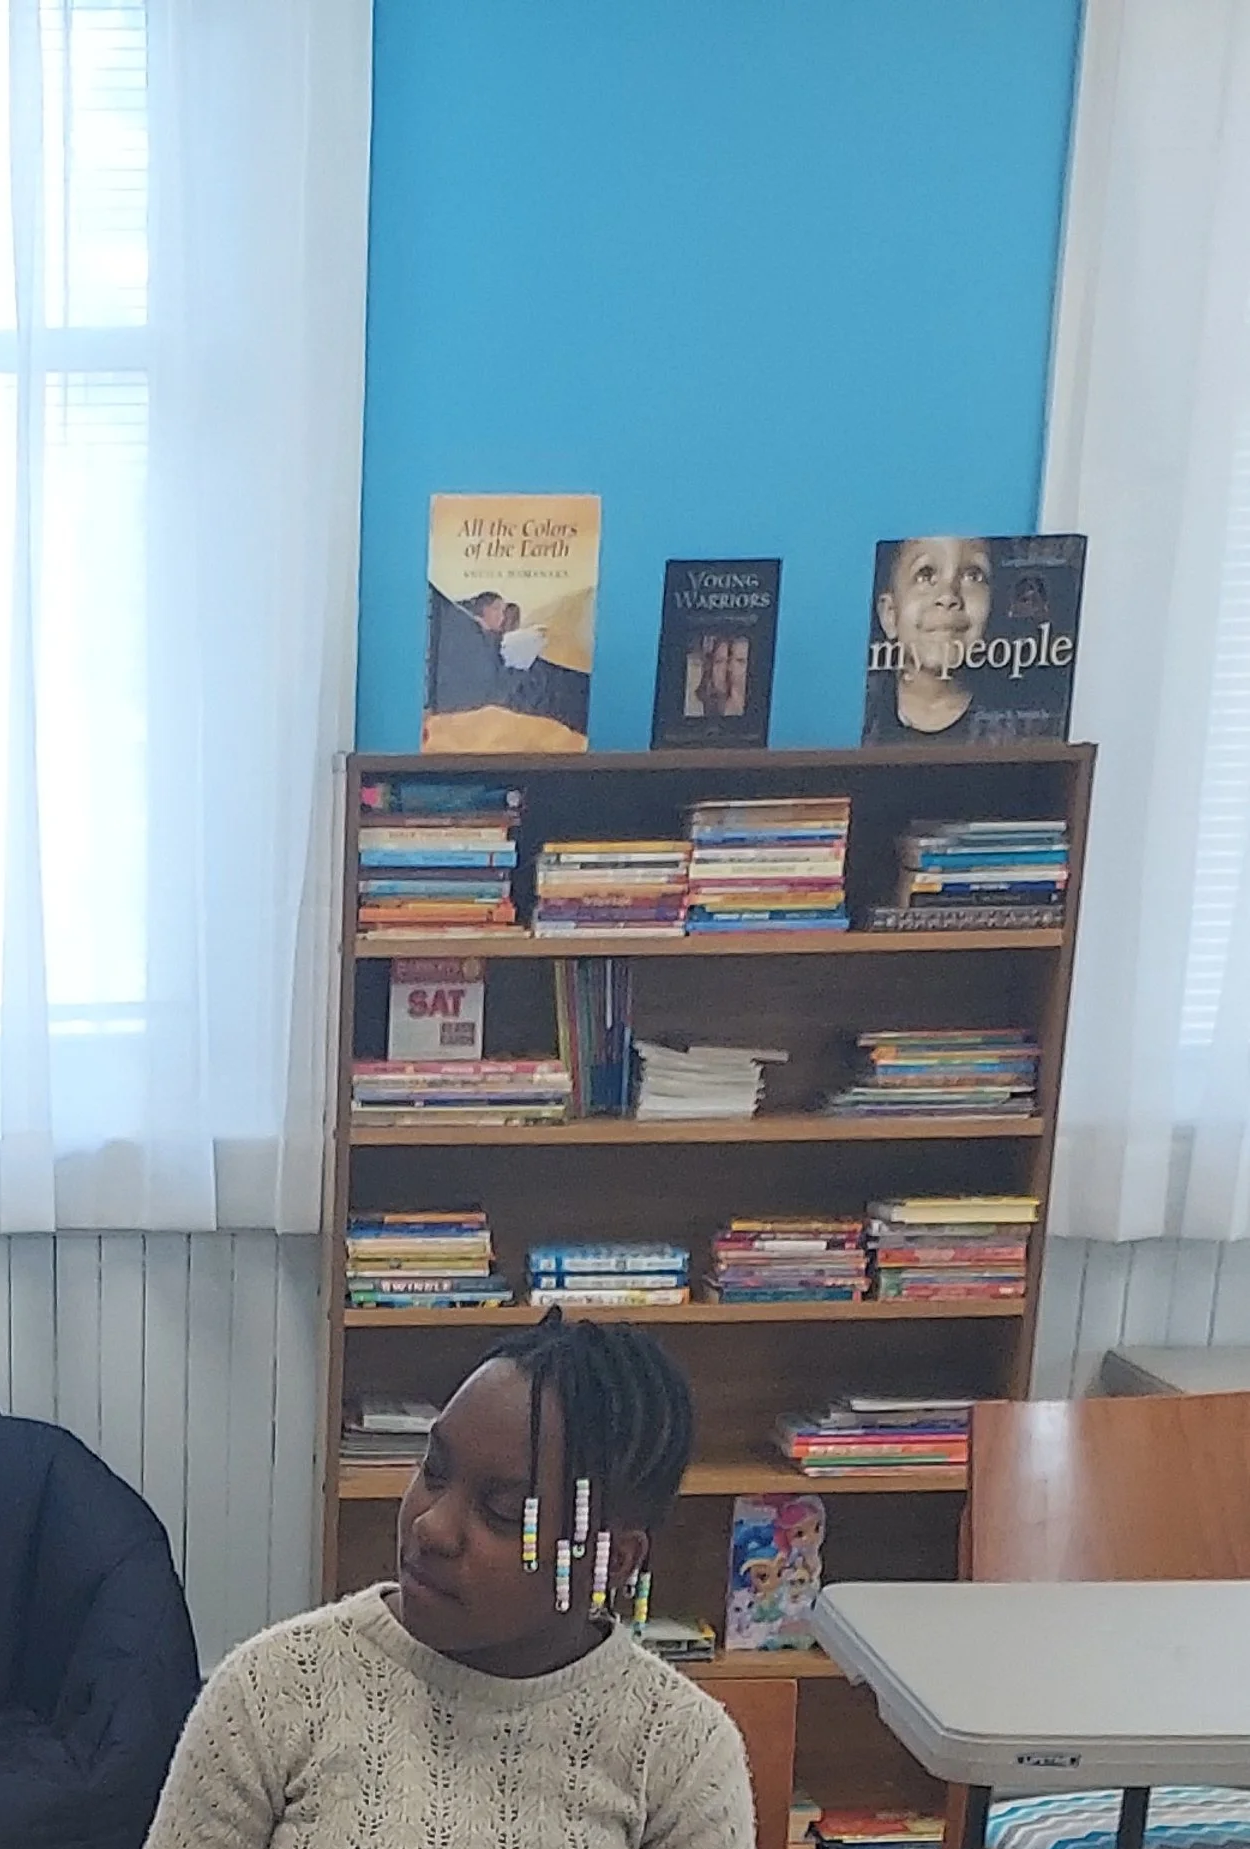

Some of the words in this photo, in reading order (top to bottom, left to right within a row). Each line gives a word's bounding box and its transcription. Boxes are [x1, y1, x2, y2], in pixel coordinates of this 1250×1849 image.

[457, 517, 484, 538] All
[489, 517, 517, 538] the
[522, 518, 578, 538] Colors
[464, 539, 484, 560] of
[487, 539, 515, 558] the
[520, 540, 570, 558] Earth
[686, 570, 759, 590] YOUNG
[675, 590, 772, 609] WARRIORS
[868, 639, 925, 682] my
[934, 621, 1074, 681] people
[407, 989, 466, 1020] SAT
